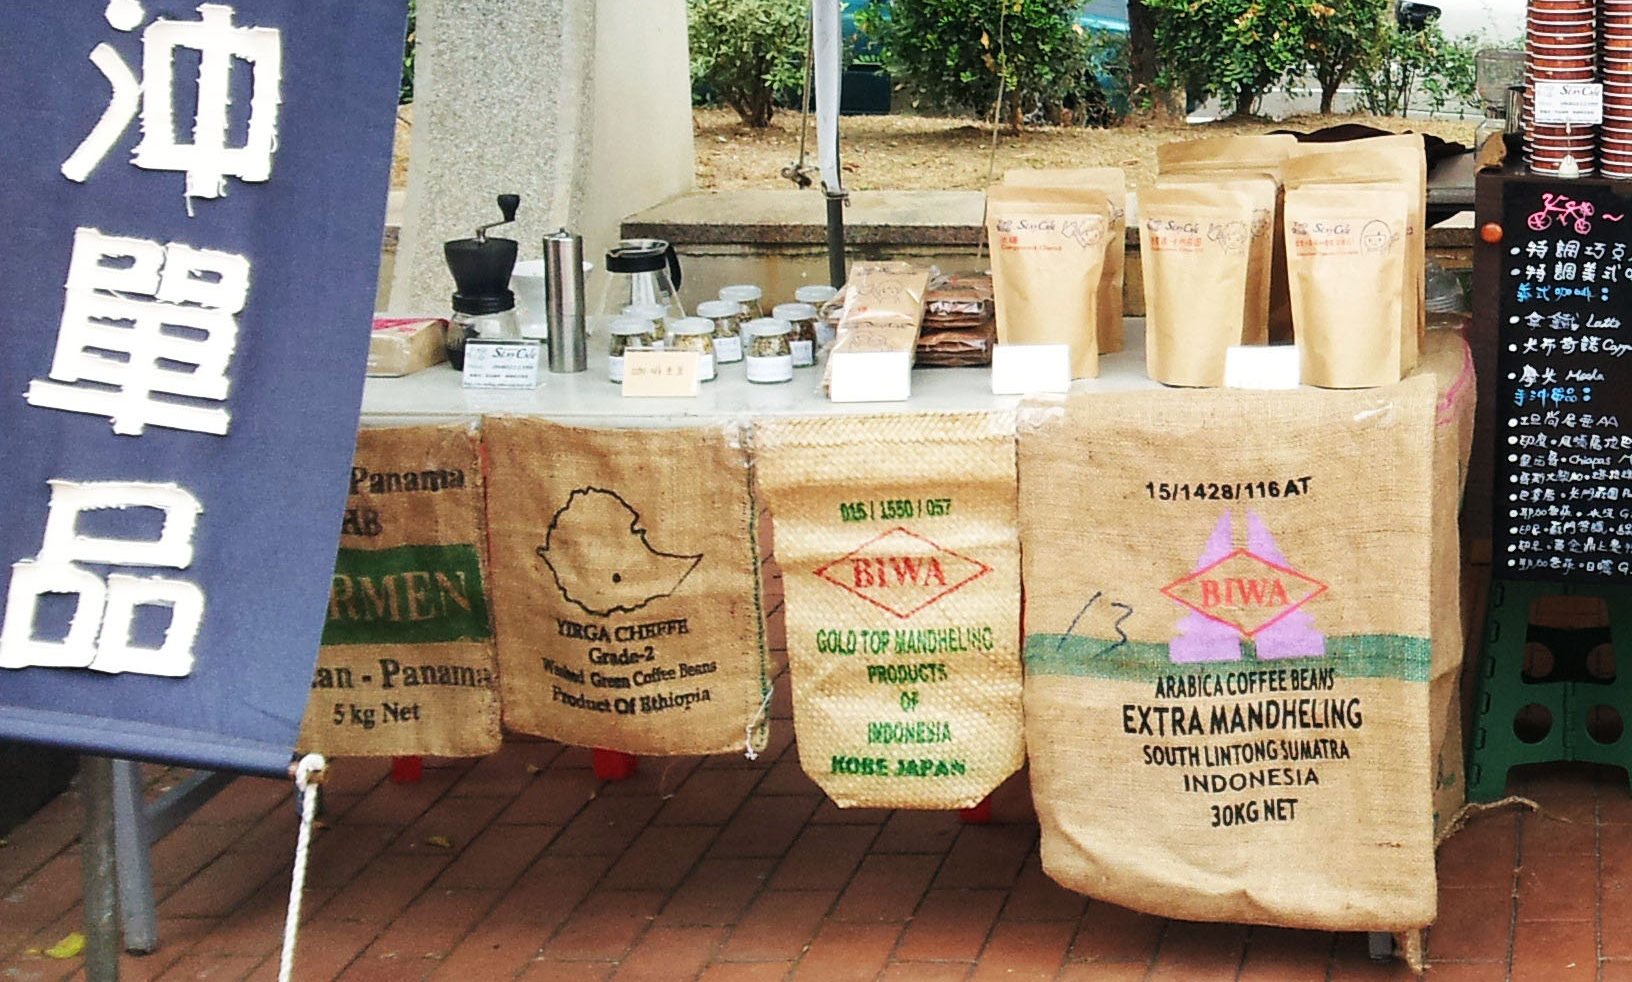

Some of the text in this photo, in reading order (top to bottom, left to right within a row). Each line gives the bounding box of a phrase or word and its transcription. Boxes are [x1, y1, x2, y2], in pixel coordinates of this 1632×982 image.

[850, 555, 948, 589] BIWA
[1200, 576, 1292, 609] BIWA
[556, 617, 689, 642] YIRGA CHEFFE
[815, 626, 994, 656] GOLD TOP MANDHELING
[588, 646, 655, 666] Grade-2
[590, 671, 631, 690] Green
[633, 666, 676, 688] Coffee
[679, 658, 718, 680] Beans
[866, 662, 949, 685] PRODUCTS
[1155, 666, 1335, 699] ARABICA COFFEE BEANS
[551, 684, 711, 714] Product Of Ethiopia
[899, 690, 919, 712] OF
[333, 701, 421, 729] 5 kg Net
[1121, 696, 1363, 737] EXTRA MANDHELING
[866, 721, 952, 745] INDONESIA
[830, 755, 966, 777] KOBE JAPAN
[1142, 738, 1350, 768] SOUTH LINTONG SUMATRA
[1182, 769, 1320, 794] INDONESIA
[1210, 797, 1299, 828] 30KG NET
